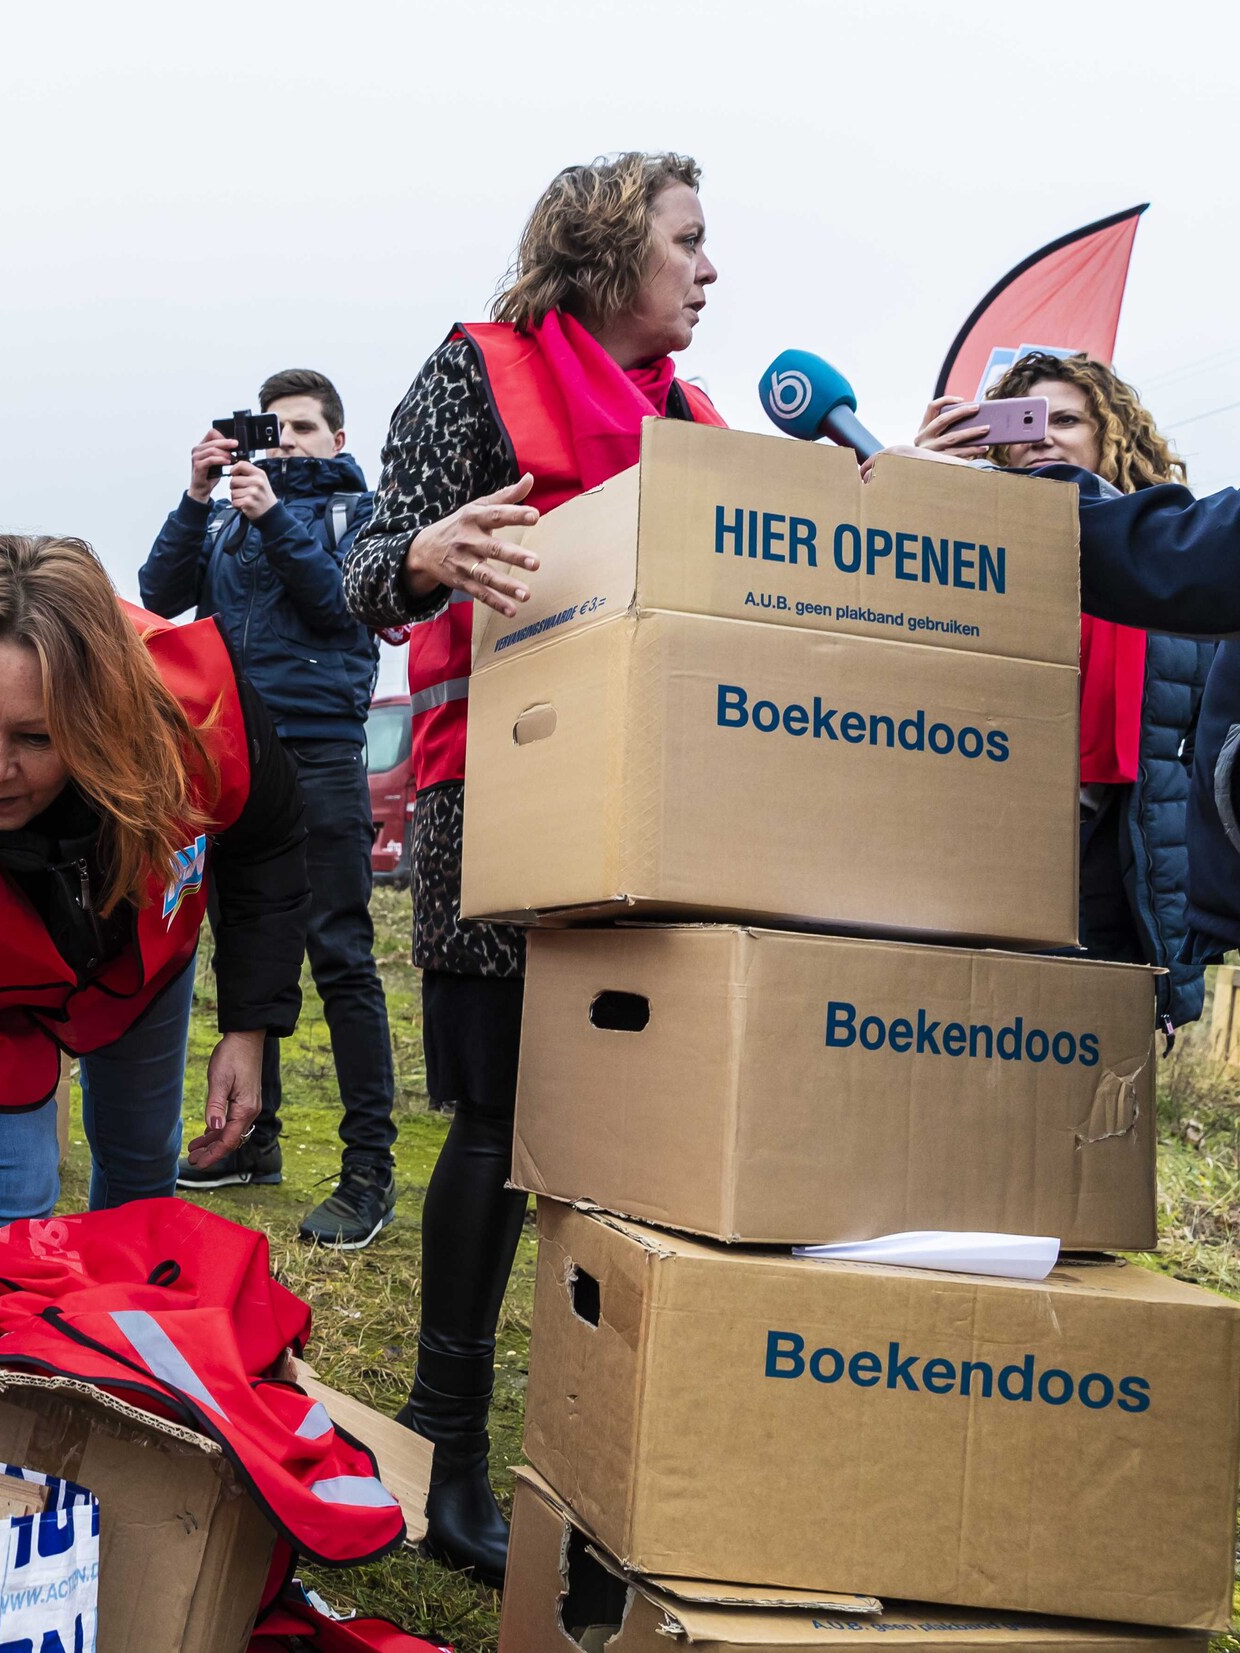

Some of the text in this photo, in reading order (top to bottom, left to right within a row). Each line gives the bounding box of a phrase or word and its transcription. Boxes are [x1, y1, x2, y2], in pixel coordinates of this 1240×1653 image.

[715, 505, 1006, 594] HIER OPENEN
[744, 592, 980, 637] A.U.B. geen plakband gebruiken
[717, 684, 1010, 762] Boekendoos
[825, 1001, 1100, 1067] Boekendoos
[764, 1330, 1151, 1413] Boekendoos
[812, 1619, 865, 1632] A.U.B.
[870, 1622, 916, 1632] geen
[918, 1621, 1001, 1632] plakband
